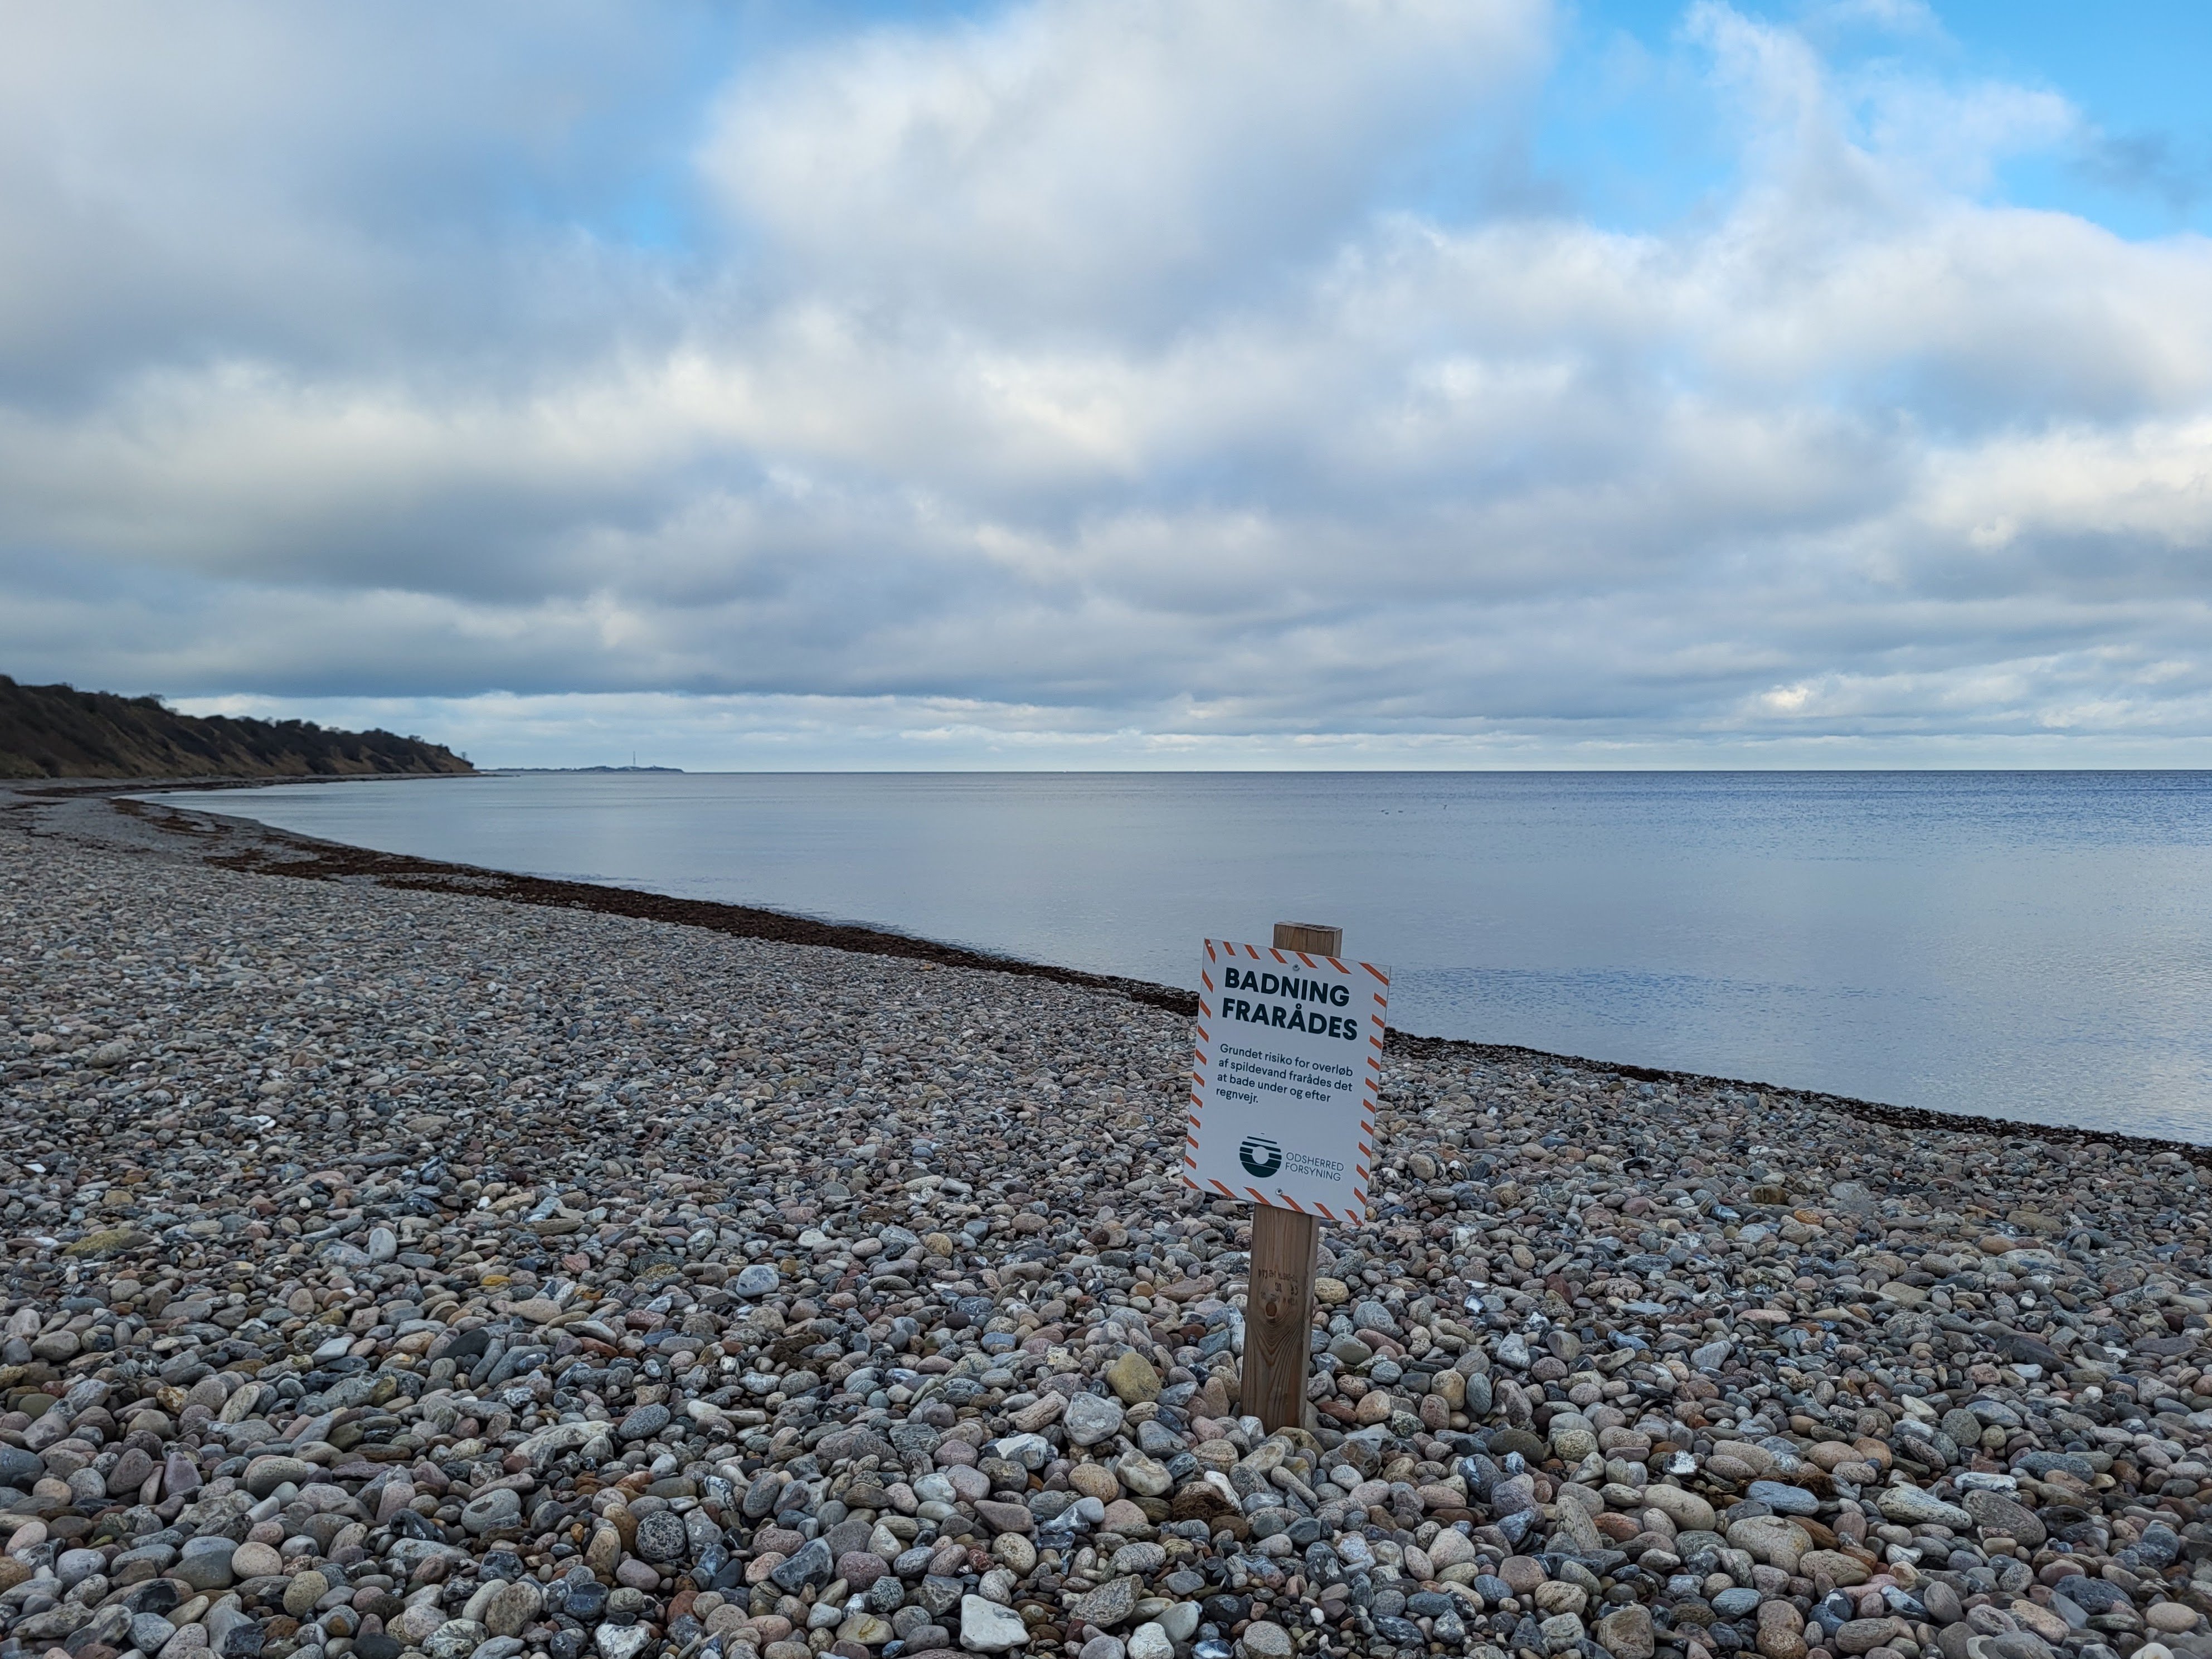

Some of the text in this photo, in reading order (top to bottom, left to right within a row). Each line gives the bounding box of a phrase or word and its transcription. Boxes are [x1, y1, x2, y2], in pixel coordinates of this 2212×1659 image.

[1225, 967, 1349, 1007] BADNING
[1222, 997, 1358, 1040] FRARÅDES
[1218, 1059, 1353, 1092] af spildevand frarådes det
[1220, 1044, 1353, 1077] Grundet risiko for overløb
[1216, 1088, 1259, 1104] regnvejr.
[1217, 1074, 1331, 1103] at bade under og efter
[1285, 1162, 1341, 1181] FORSYNING
[1286, 1152, 1344, 1171] ODSHERRED
